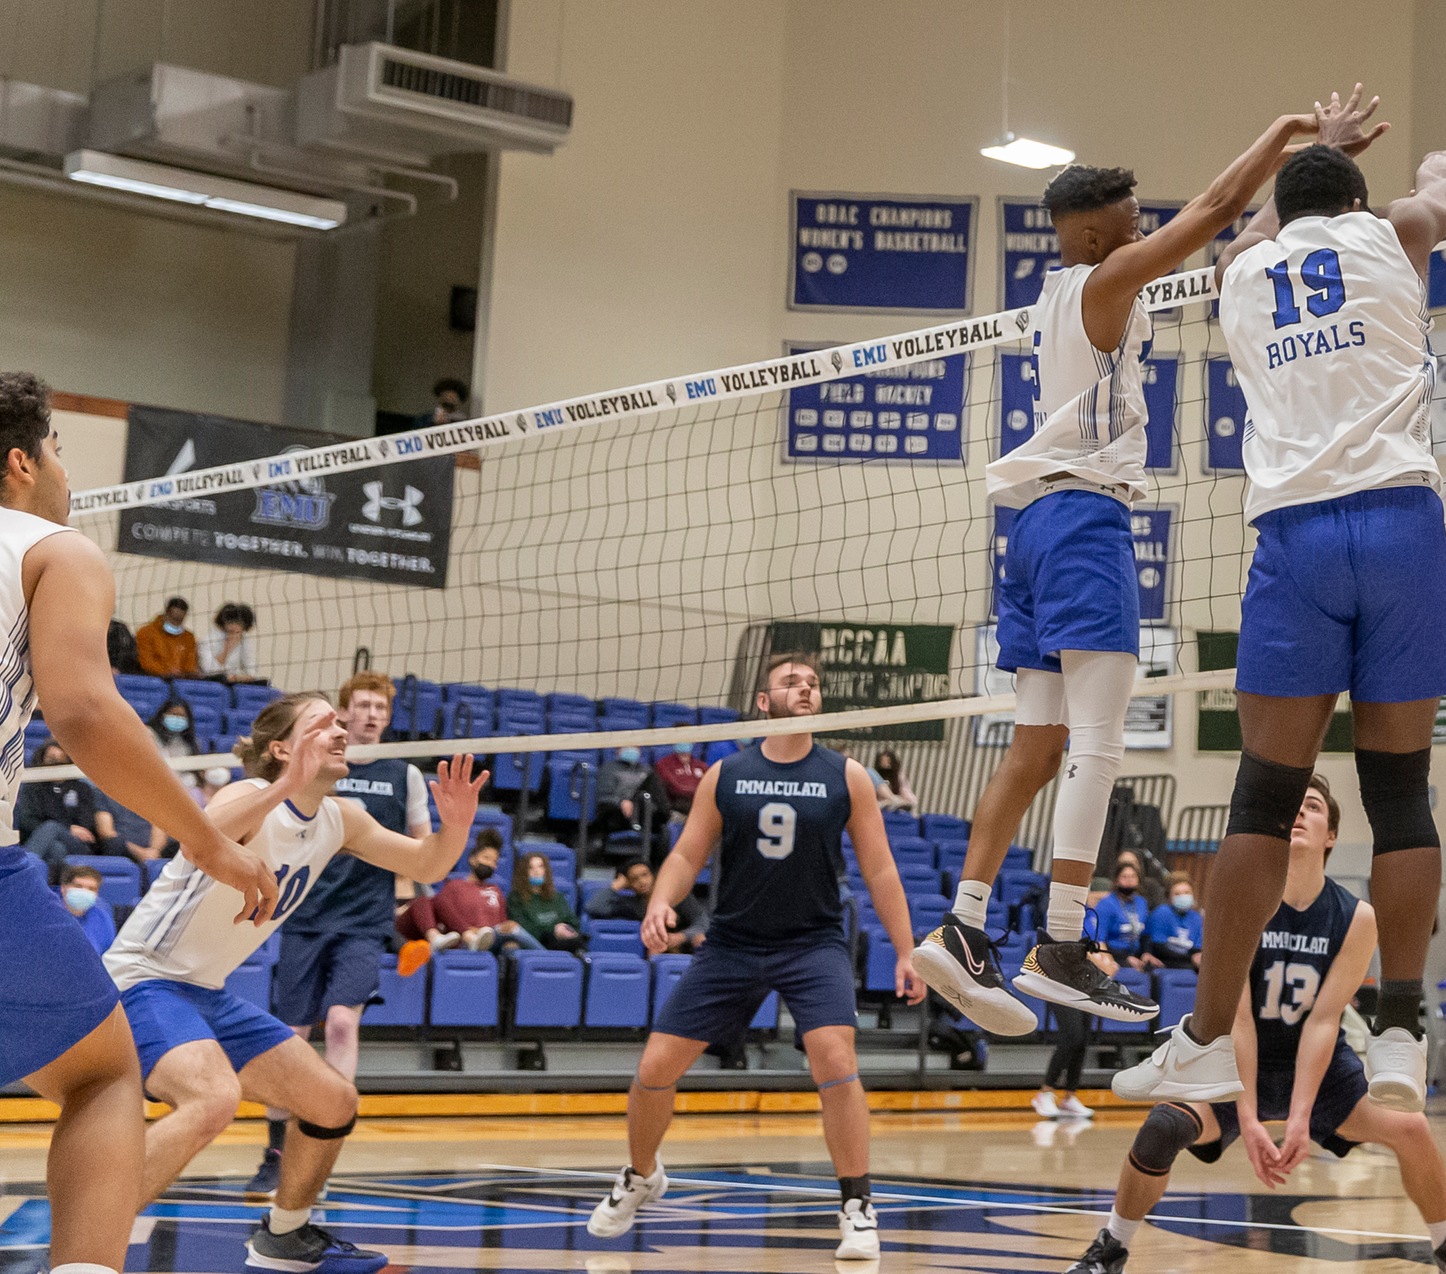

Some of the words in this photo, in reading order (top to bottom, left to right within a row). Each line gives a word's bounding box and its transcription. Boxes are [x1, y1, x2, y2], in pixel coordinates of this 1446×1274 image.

[1265, 248, 1346, 330] 19
[1266, 321, 1366, 369] ROYALS
[71, 489, 129, 511] OLLEYBALL
[426, 421, 510, 450] VOLLEYBALL
[534, 409, 564, 428] EMU
[566, 391, 658, 422] VOLLEYBALL
[686, 379, 717, 399] EMU
[721, 359, 821, 394] VOLLEYBALL
[853, 345, 887, 368] EMU
[893, 320, 1003, 360] VOLLEYBALL
[260, 490, 323, 523] EMU
[735, 779, 827, 798] IMMACULATA
[757, 802, 797, 860] 9
[1259, 960, 1321, 1025] 13
